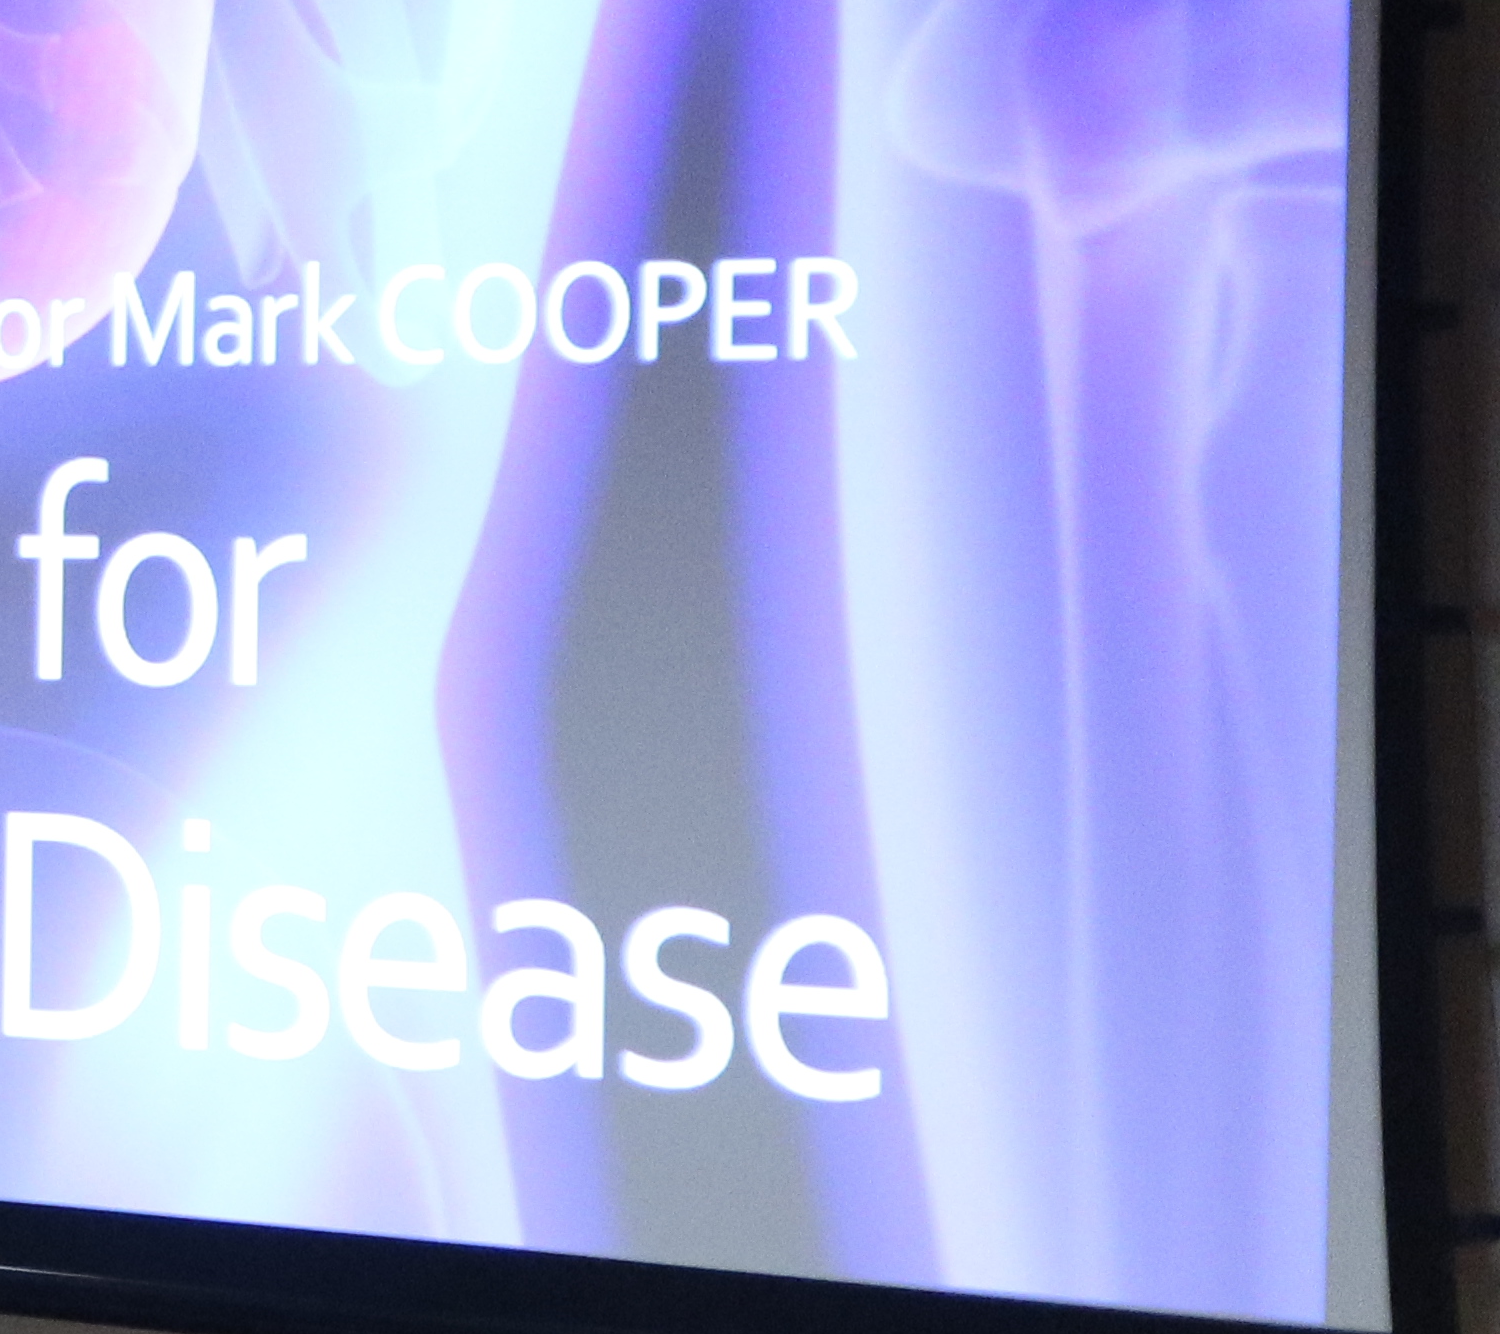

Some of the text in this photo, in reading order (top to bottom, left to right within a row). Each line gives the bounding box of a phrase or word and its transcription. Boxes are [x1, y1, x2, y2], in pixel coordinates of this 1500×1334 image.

[110, 270, 356, 367] Mark
[376, 257, 861, 364] COOPER
[18, 457, 307, 688] for
[1, 810, 890, 1100] Disease
